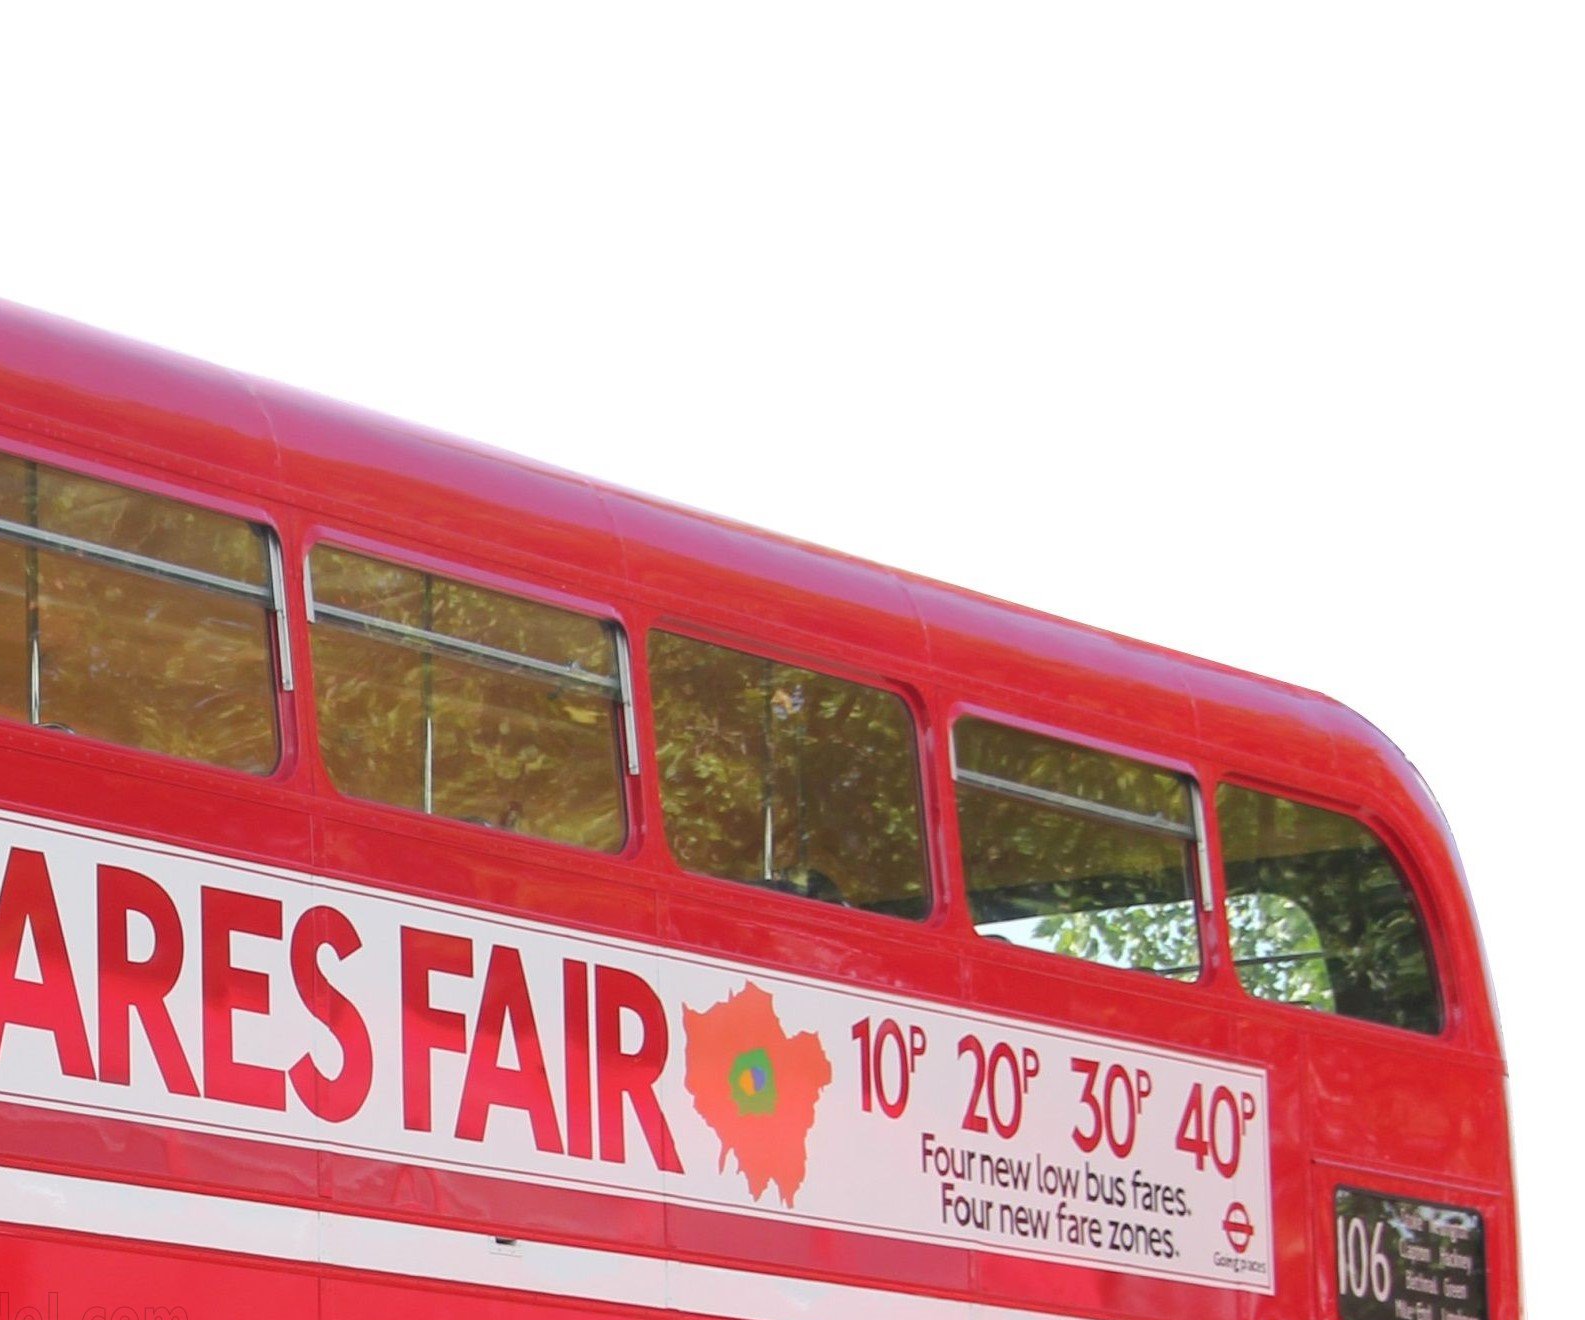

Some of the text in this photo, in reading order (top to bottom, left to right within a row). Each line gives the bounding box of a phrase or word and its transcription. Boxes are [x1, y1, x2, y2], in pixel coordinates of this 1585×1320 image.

[401, 925, 686, 1174] FAIR
[921, 1133, 1192, 1217] Four new low bus fares.
[941, 1182, 1180, 1258] Four new fare zones.
[1337, 1216, 1392, 1303] 106
